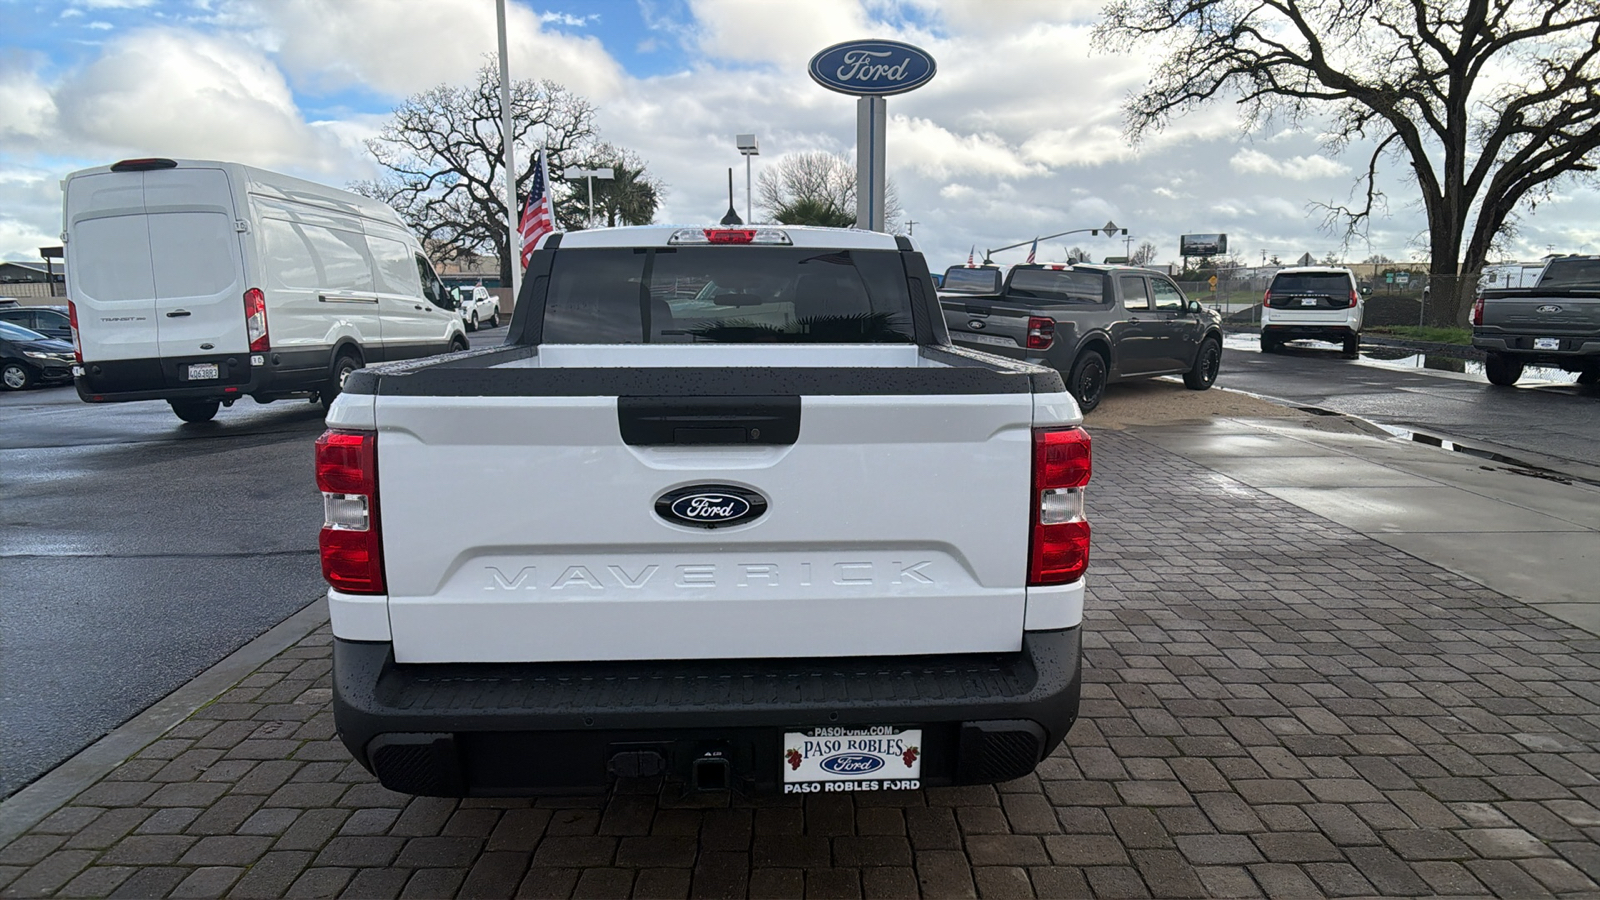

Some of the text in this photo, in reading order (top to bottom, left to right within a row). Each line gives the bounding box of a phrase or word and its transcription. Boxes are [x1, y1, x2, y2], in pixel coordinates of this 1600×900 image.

[836, 50, 911, 81] Ford
[686, 497, 735, 517] Ford
[484, 559, 935, 591] MAVERICK
[804, 738, 903, 759] PASO ROBLES
[833, 756, 873, 771] Ford
[784, 780, 920, 794] PASO ROBLES FORD
